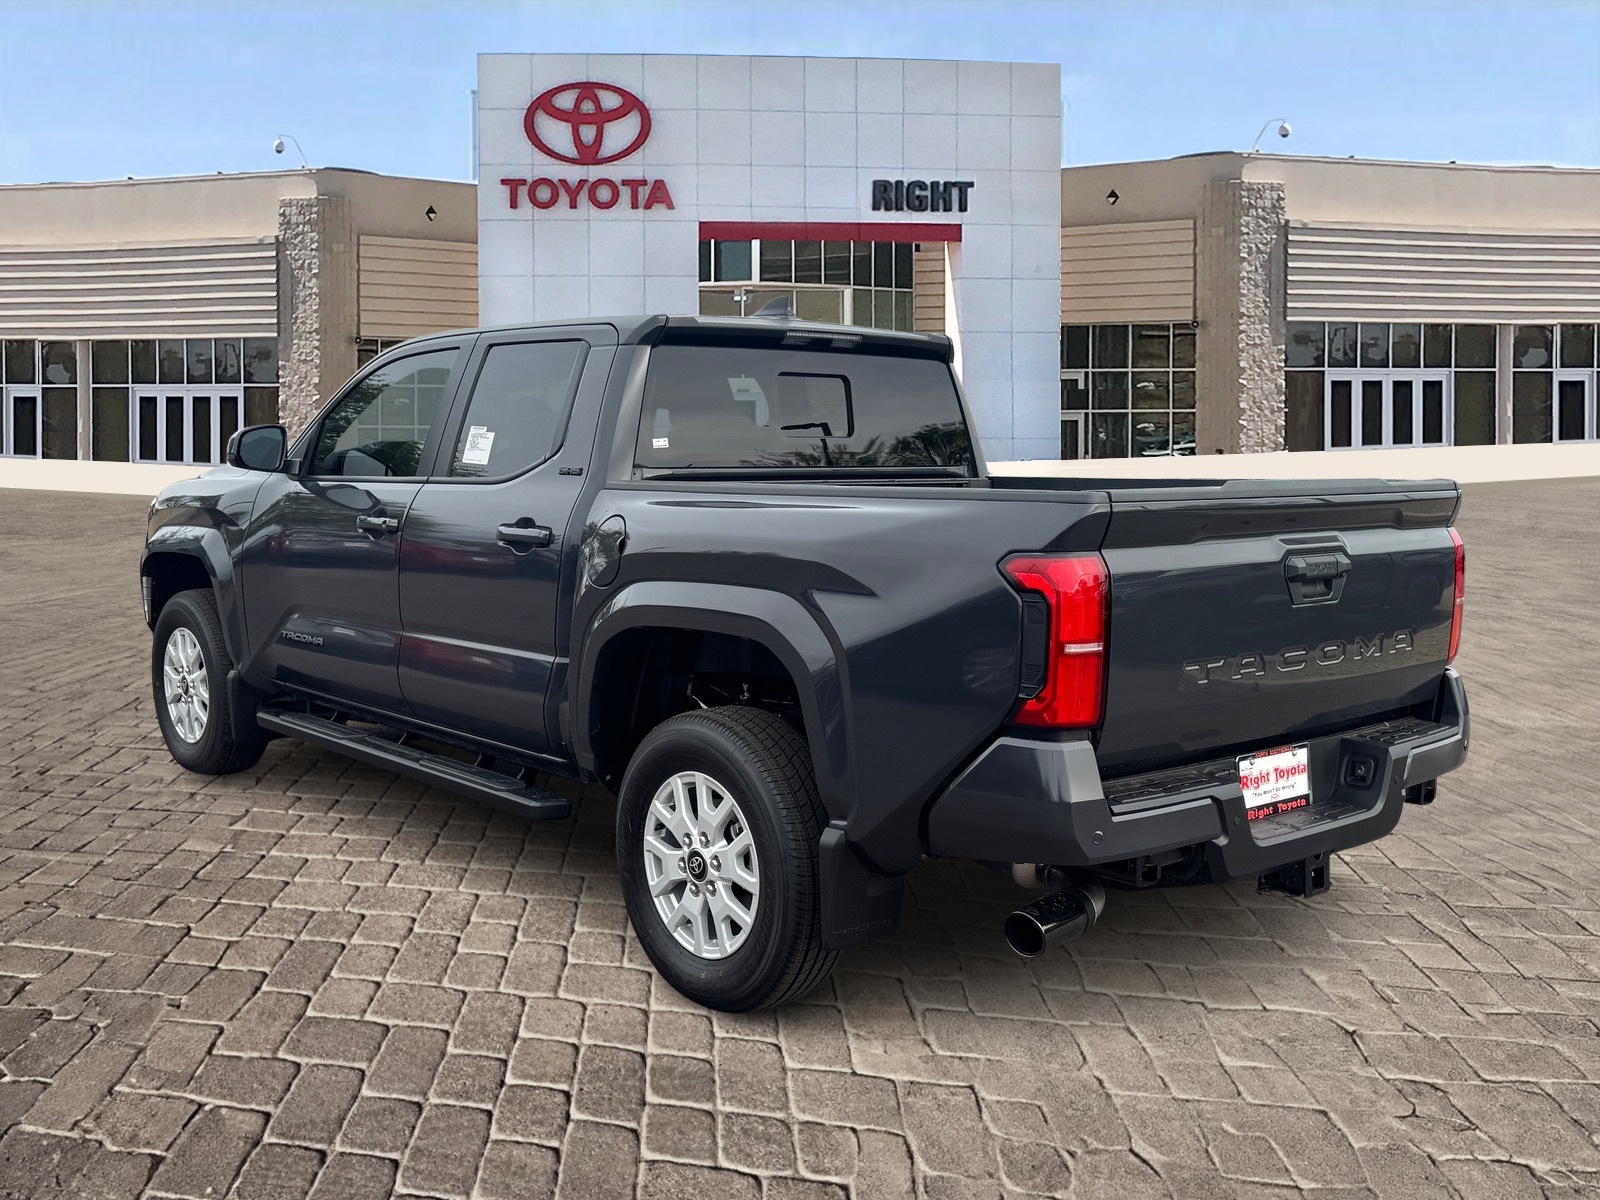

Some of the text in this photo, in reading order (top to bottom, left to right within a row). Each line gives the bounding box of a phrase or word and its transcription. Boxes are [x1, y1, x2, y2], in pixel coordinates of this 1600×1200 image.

[500, 178, 675, 209] TOYOTA
[872, 180, 974, 212] RIGHT
[281, 630, 324, 646] TACOMA
[1183, 629, 1415, 684] TACOMA
[1240, 764, 1307, 790] Right Toyota
[1248, 799, 1306, 820] Right Toyota
